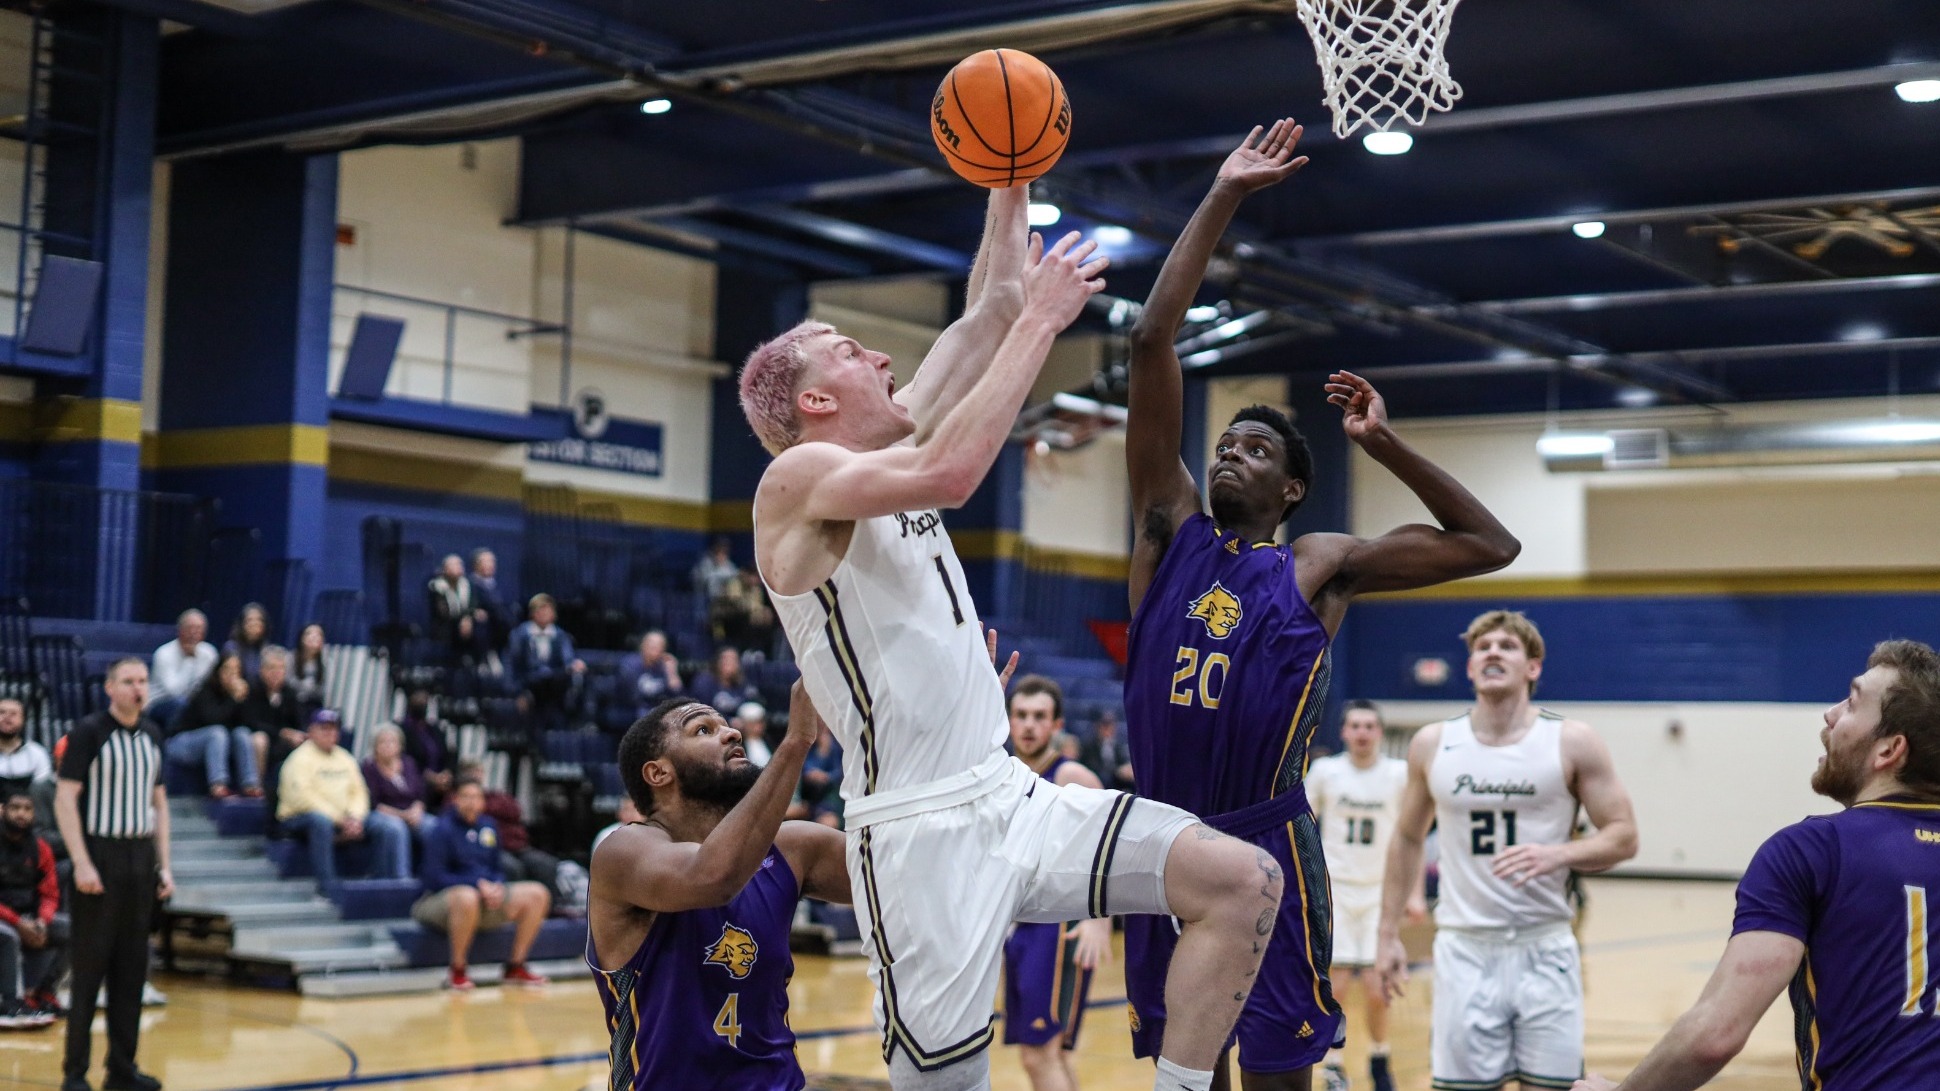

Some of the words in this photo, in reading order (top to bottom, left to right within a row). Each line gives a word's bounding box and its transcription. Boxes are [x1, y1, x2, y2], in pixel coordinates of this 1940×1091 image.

[591, 442, 657, 471] SECTION
[932, 553, 966, 628] 1
[1170, 646, 1230, 709] 20
[1452, 773, 1536, 800] Principia
[1346, 816, 1375, 845] 10
[1469, 810, 1516, 855] 21
[1899, 884, 1940, 1016] 1
[713, 993, 742, 1048] 4
